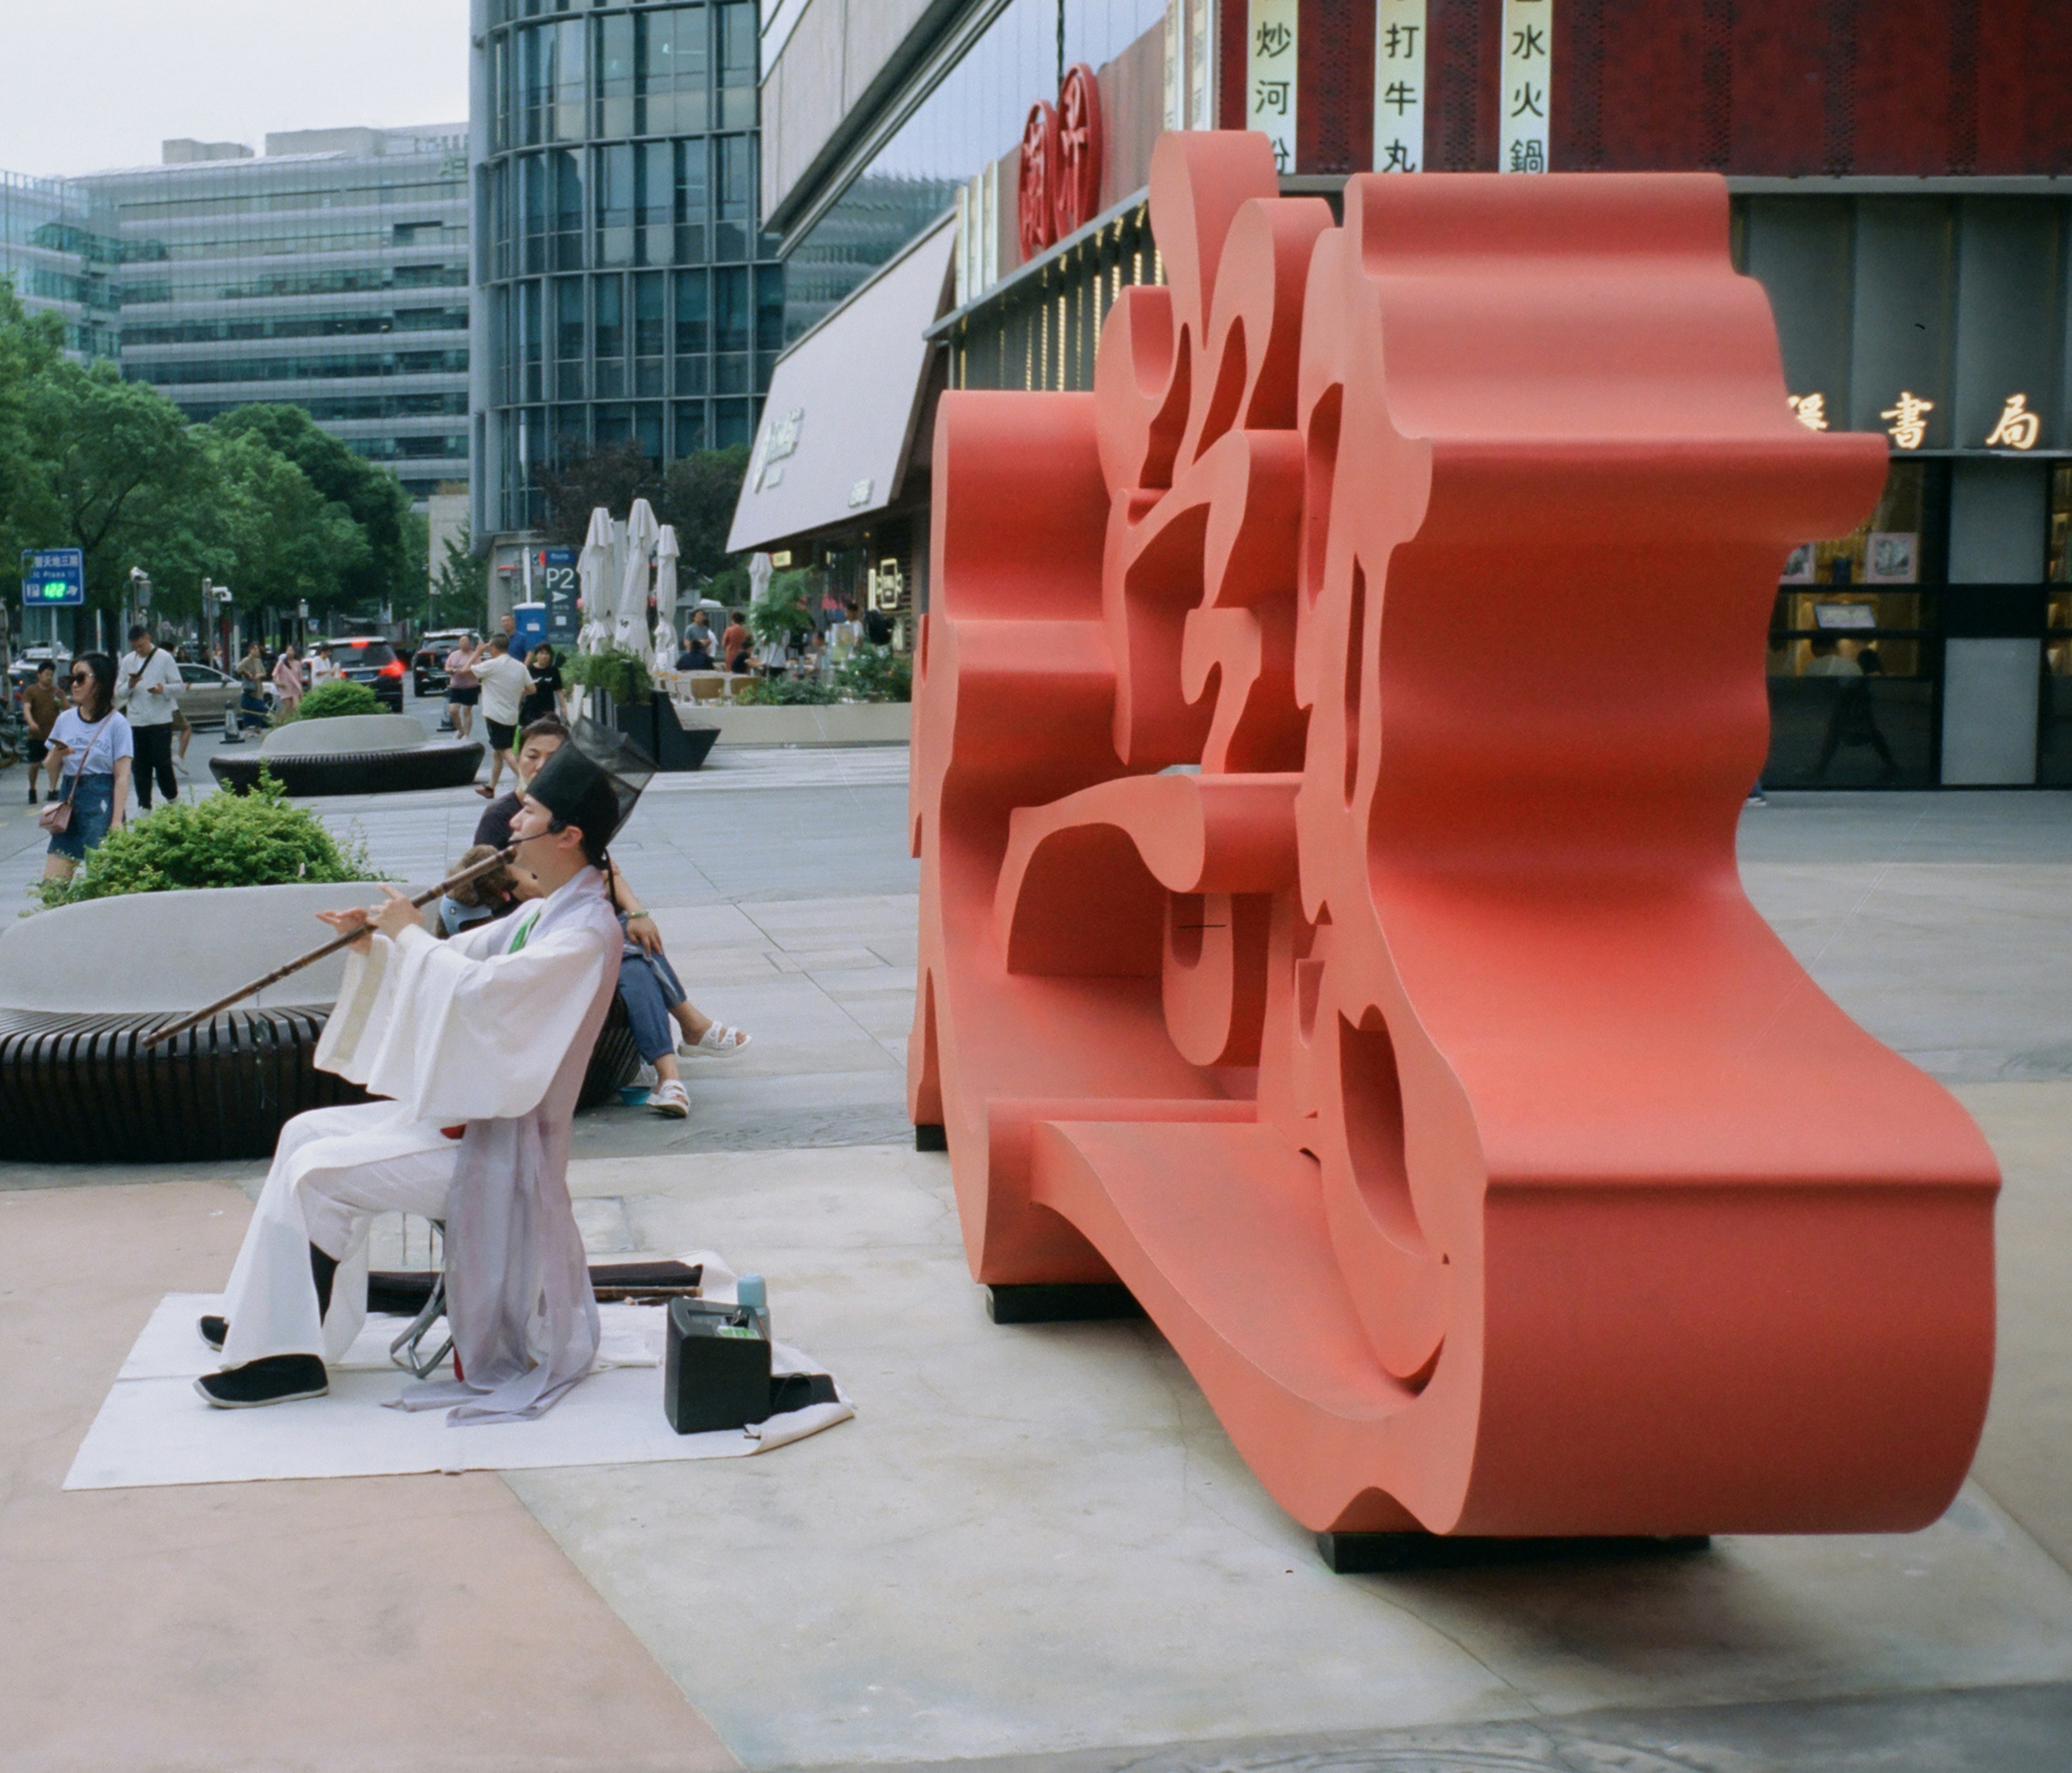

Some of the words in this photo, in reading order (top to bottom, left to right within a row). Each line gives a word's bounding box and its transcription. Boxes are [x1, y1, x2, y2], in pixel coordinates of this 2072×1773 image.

[1383, 23, 1420, 173] 打牛丸
[1510, 0, 1545, 173] 水火鍋
[546, 568, 574, 589] P2
